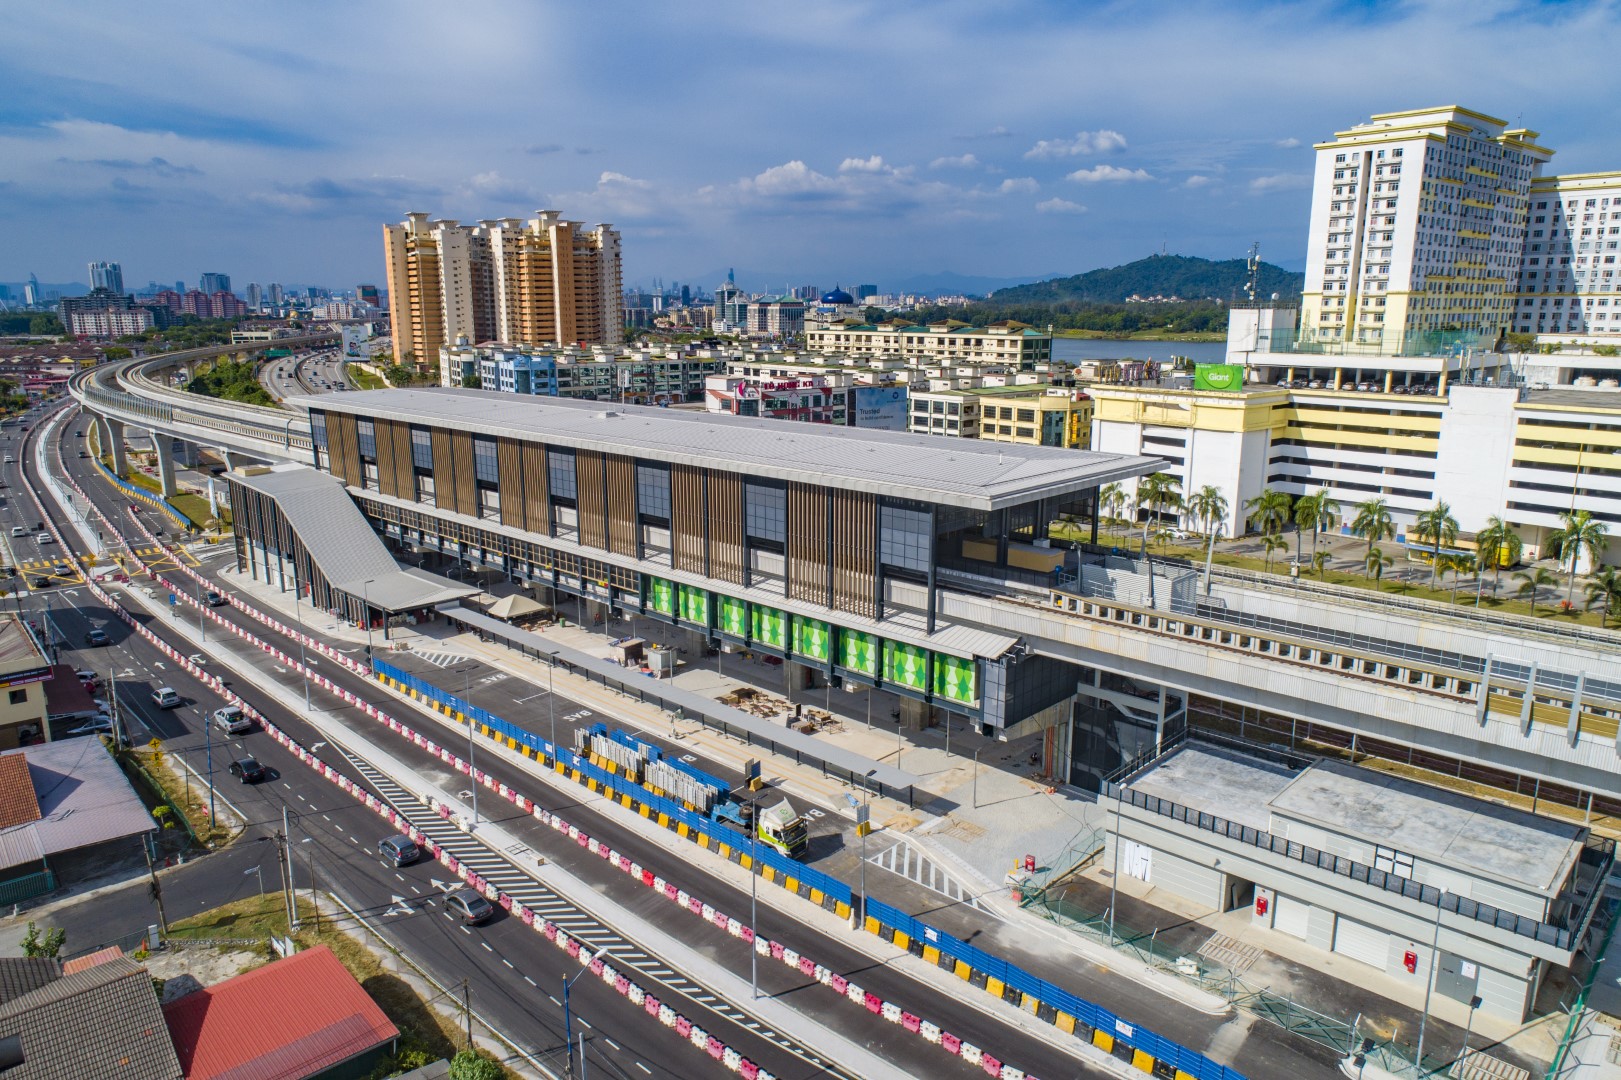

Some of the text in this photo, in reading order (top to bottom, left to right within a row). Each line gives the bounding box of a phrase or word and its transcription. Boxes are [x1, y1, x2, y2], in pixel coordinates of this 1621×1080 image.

[1208, 372, 1229, 381] Giant
[480, 673, 508, 684] BAS
[562, 709, 593, 722] BAS
